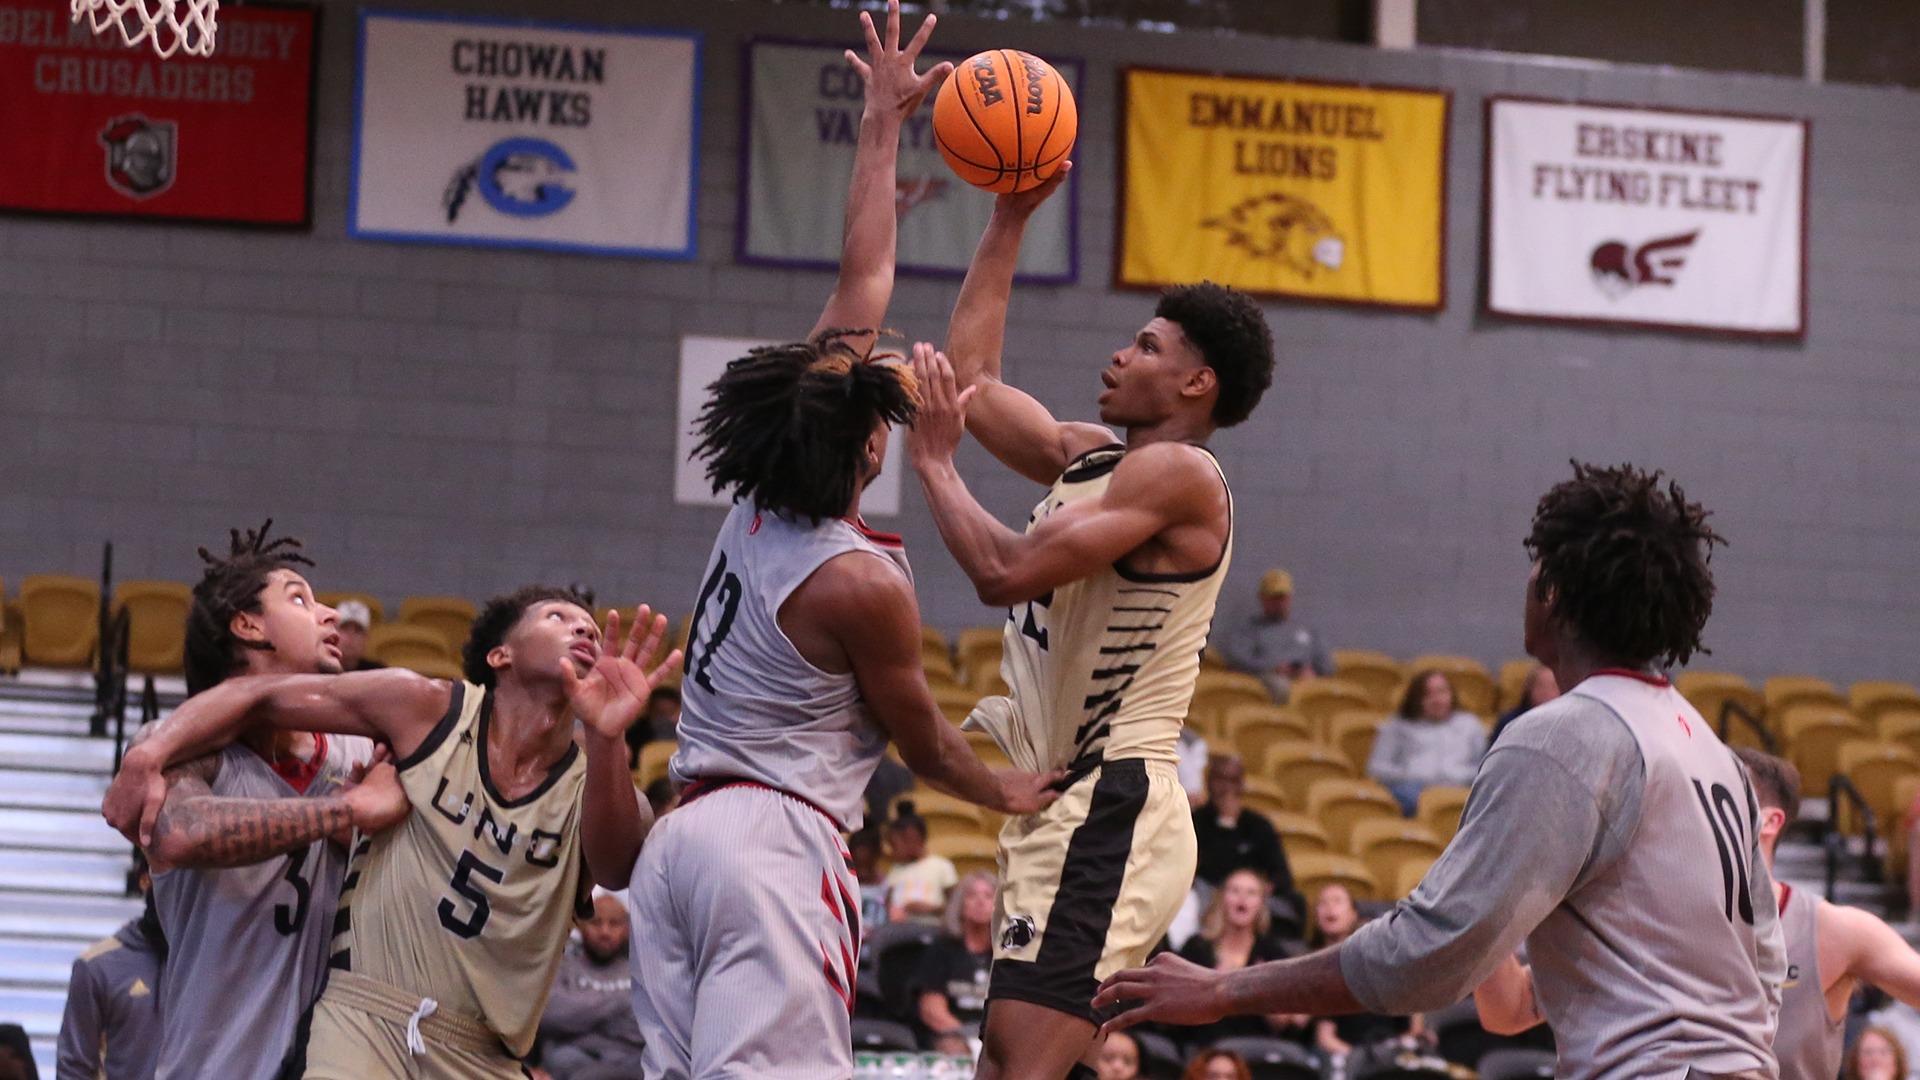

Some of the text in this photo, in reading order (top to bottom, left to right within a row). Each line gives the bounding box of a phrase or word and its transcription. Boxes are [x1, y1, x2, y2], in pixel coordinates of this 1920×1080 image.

[34, 55, 255, 102] CRUSADERS
[452, 38, 605, 84] CHOWAN
[972, 55, 1004, 107] NCAA
[465, 83, 591, 127] HAWKS
[1189, 92, 1384, 141] EMMANUEL
[1233, 139, 1337, 181] LIONS
[1576, 123, 1723, 168] ERSKINE
[1533, 164, 1760, 213] FLYING FLEET
[683, 549, 742, 695] 12
[431, 776, 562, 868] UNC
[1691, 777, 1754, 925] 10
[274, 851, 310, 936] 3
[437, 849, 504, 939] 5
